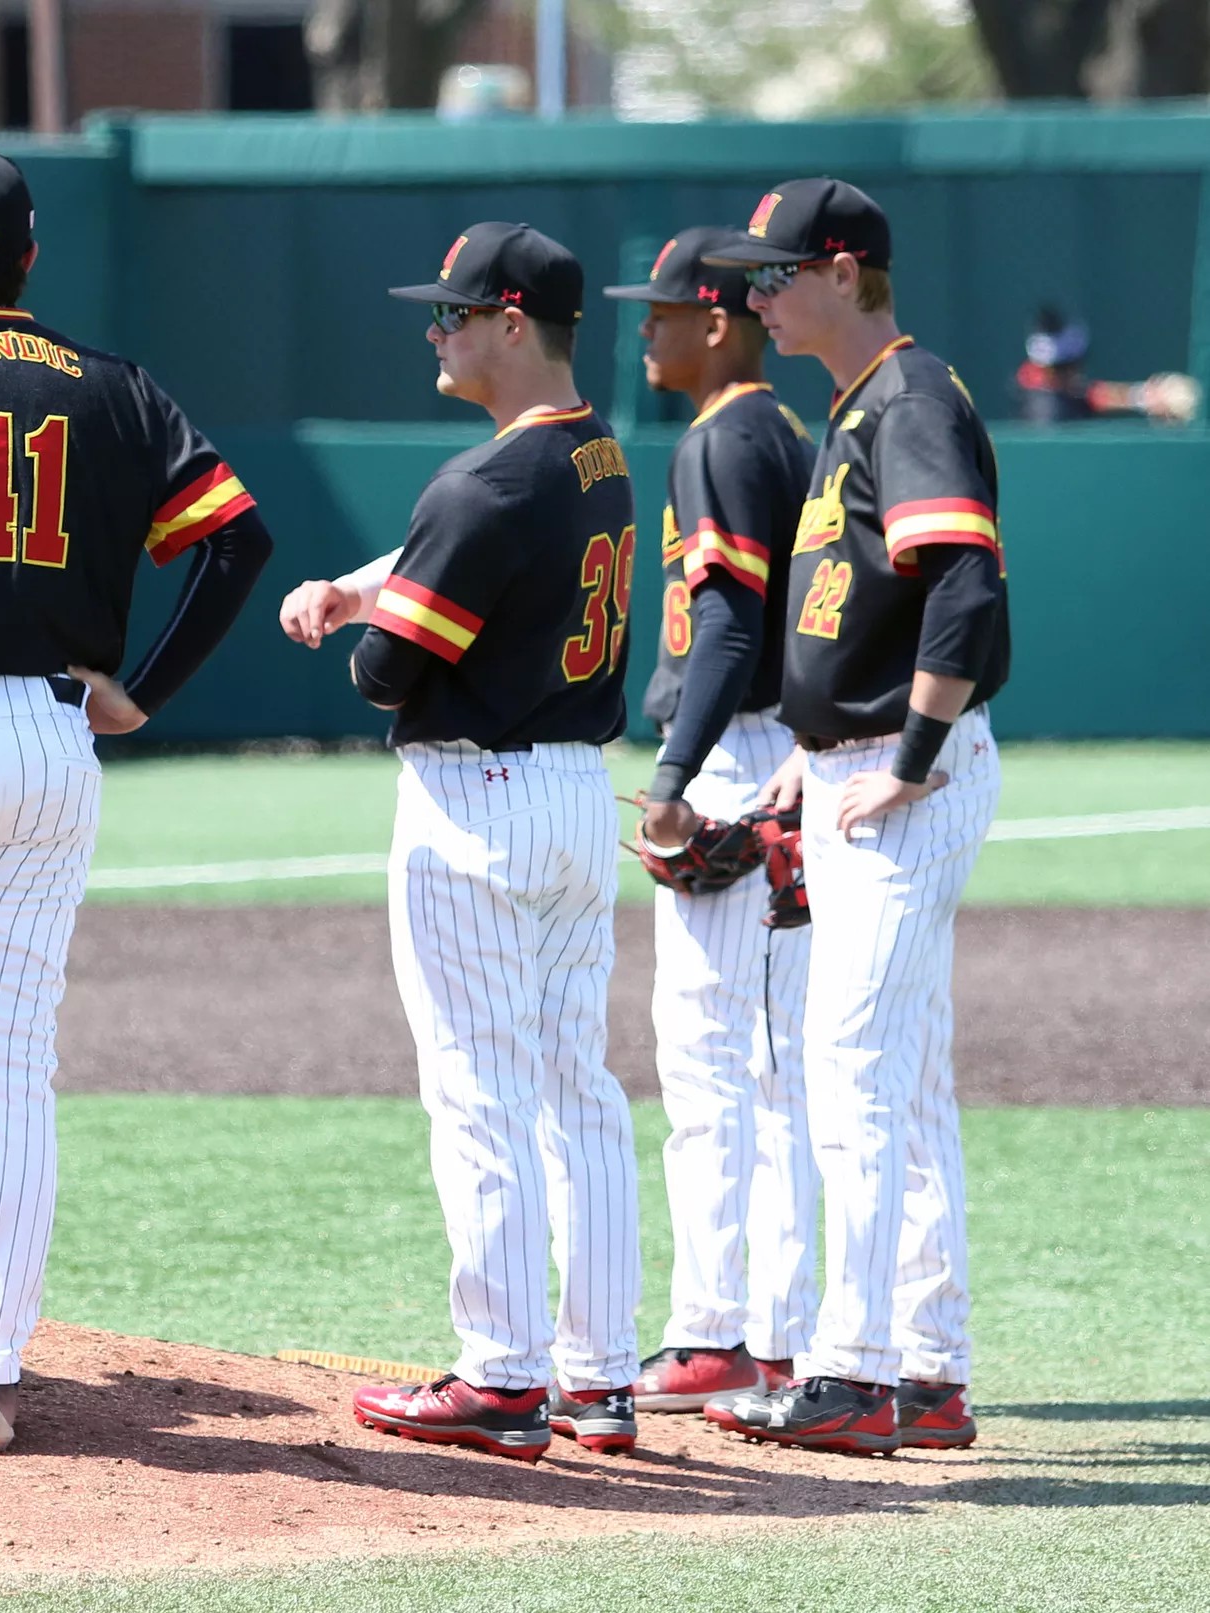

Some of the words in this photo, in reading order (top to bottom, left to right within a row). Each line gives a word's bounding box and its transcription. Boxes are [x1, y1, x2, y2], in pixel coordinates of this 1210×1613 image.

[561, 523, 636, 683] 39
[662, 580, 691, 657] 6
[796, 558, 853, 640] 22
